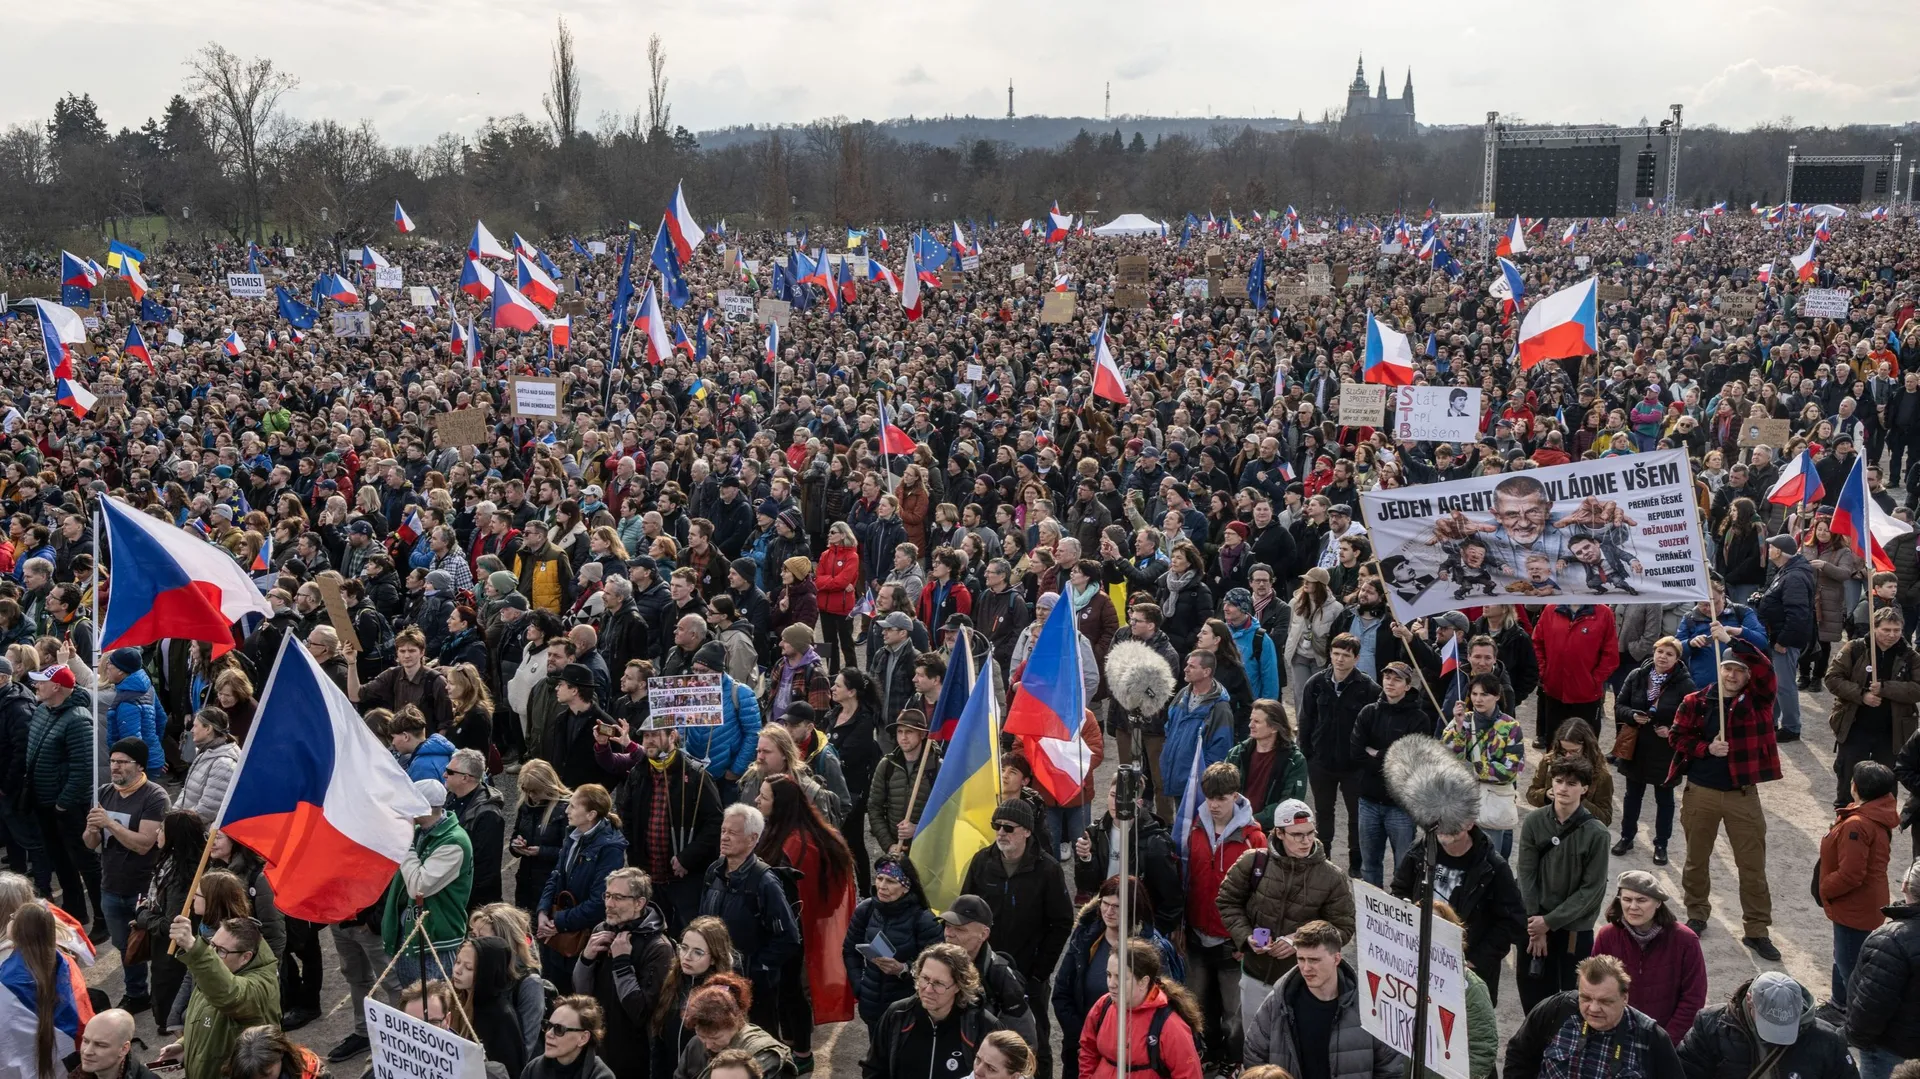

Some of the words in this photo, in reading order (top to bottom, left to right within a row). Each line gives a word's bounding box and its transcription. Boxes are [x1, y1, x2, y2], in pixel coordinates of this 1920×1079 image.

[231, 277, 262, 286] DEMISI
[725, 303, 746, 314] ÚTULEK
[1400, 386, 1438, 406] Stát
[1399, 407, 1432, 422] Trpí
[1400, 423, 1460, 438] Babišem
[1378, 499, 1433, 521] JEDEN
[1438, 490, 1492, 514] AGENT
[1544, 473, 1616, 502] VLÁDNE
[1622, 462, 1680, 490] VŠEM
[1628, 497, 1658, 509] PREMIÉR
[1660, 492, 1683, 506] ČESKÉ
[1648, 509, 1685, 521] REPUBLIKY
[1642, 522, 1687, 536] OBŽALOVANÝ
[1658, 536, 1689, 548] SOUZENÝ
[1655, 550, 1692, 562] CHRÁNĚNÝ
[1645, 565, 1694, 577] POSLANECKOU
[1662, 579, 1696, 589] IMUNITOU
[1365, 894, 1413, 927] NECHCEME
[1366, 914, 1403, 946] ZADLUŽOVAT
[1406, 935, 1420, 953] NAŠ
[1430, 947, 1459, 974] NOUČATA
[1368, 942, 1374, 956] A
[1382, 973, 1432, 1009] STO
[370, 1008, 377, 1022] S
[385, 1013, 459, 1060] BUREŠOVCI
[379, 1030, 453, 1074] PITOMIOVCI
[378, 1064, 394, 1079] NA
[382, 1049, 449, 1079] VEJFUKÁŘ
